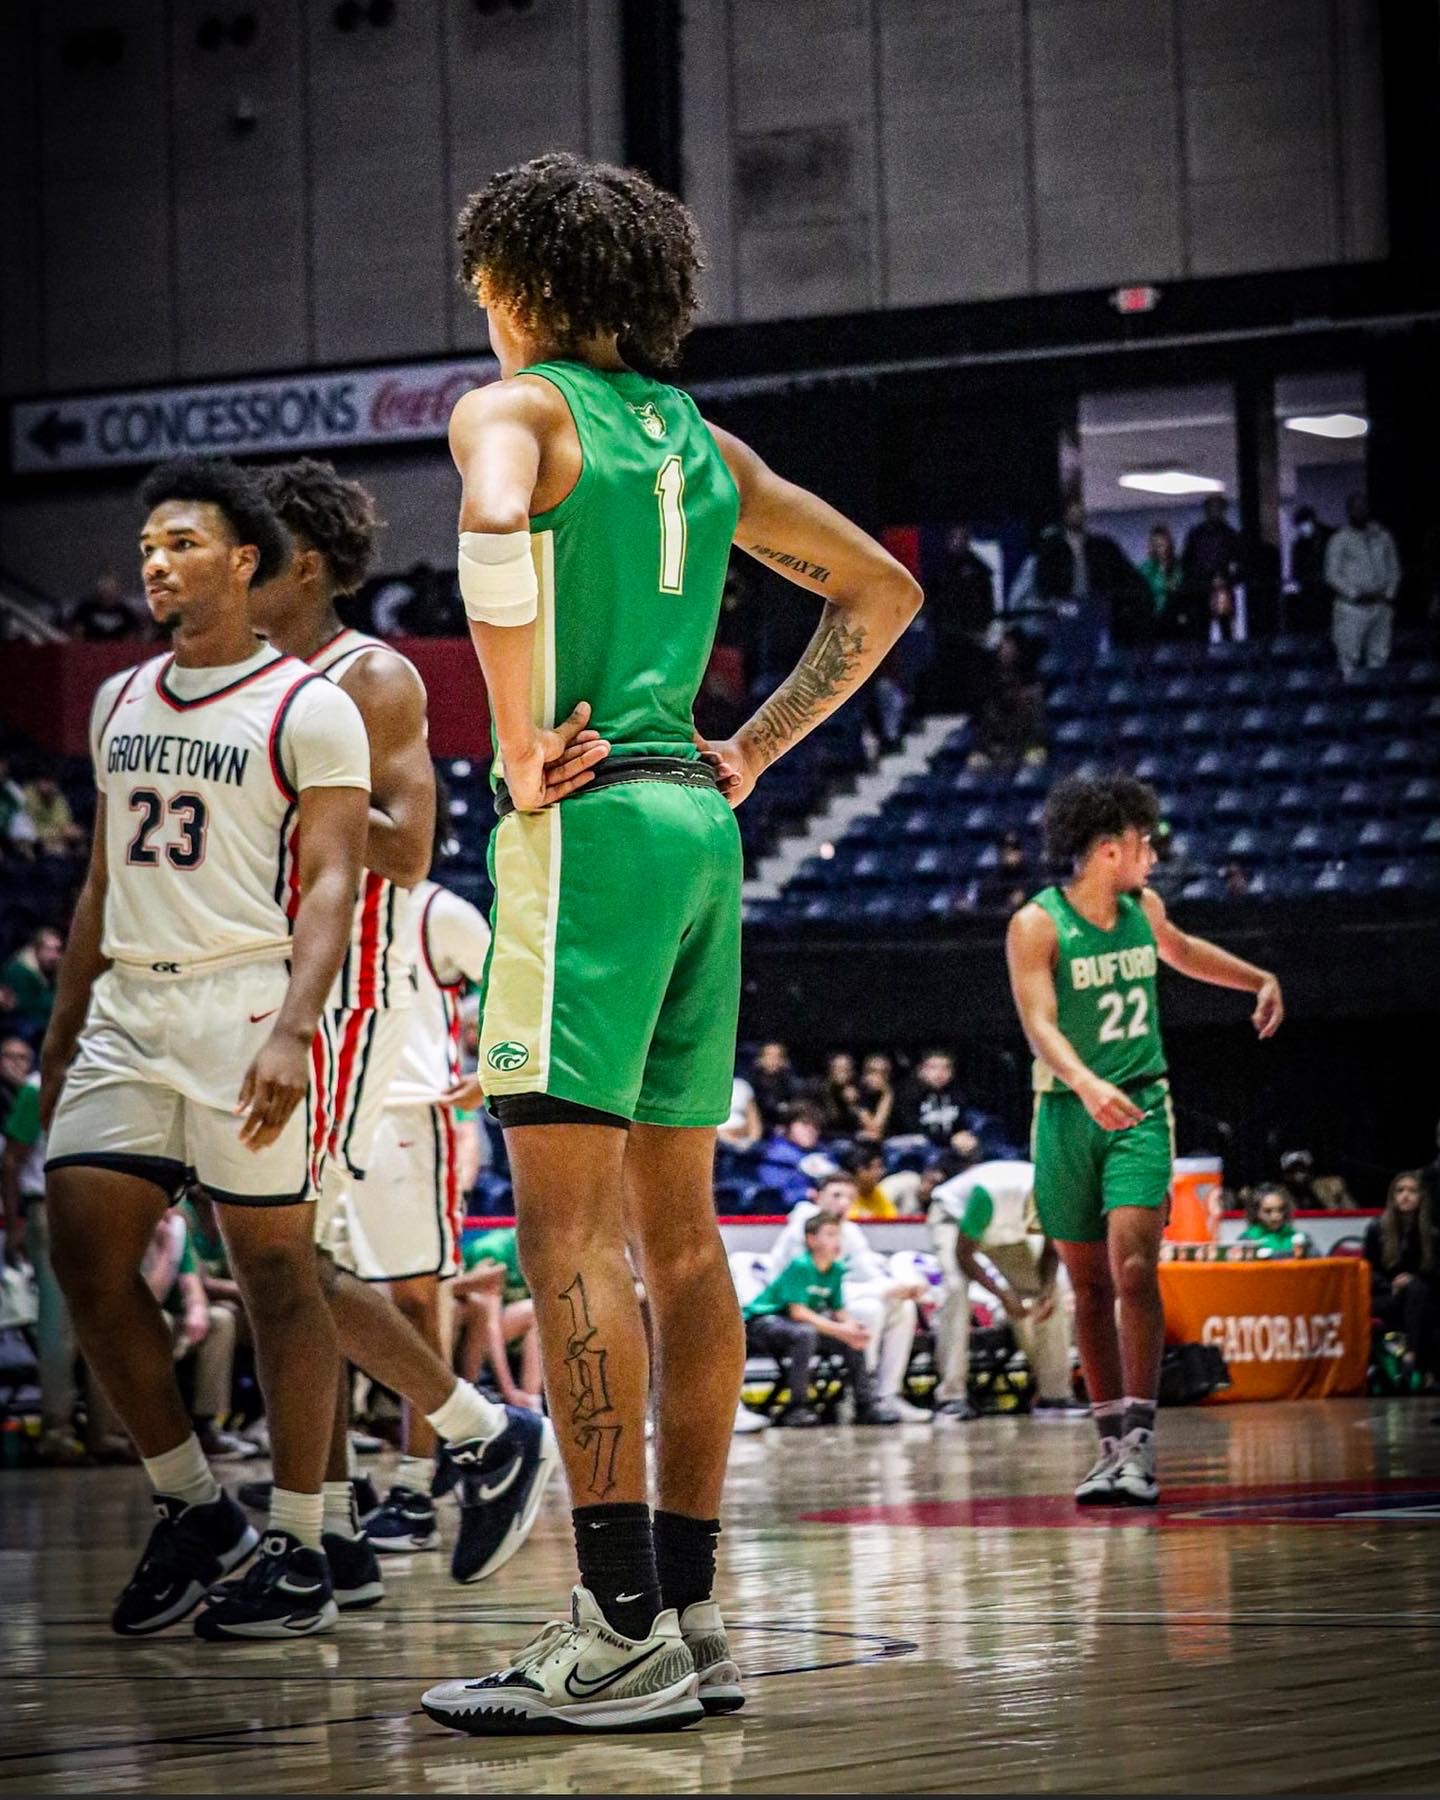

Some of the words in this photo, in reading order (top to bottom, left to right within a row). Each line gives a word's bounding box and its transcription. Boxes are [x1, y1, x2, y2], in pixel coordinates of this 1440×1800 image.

[98, 383, 358, 454] CONCESSIONS
[654, 454, 687, 596] 1
[107, 733, 249, 787] GROVETOWN
[126, 786, 210, 871] 23
[1097, 986, 1149, 1044] 22
